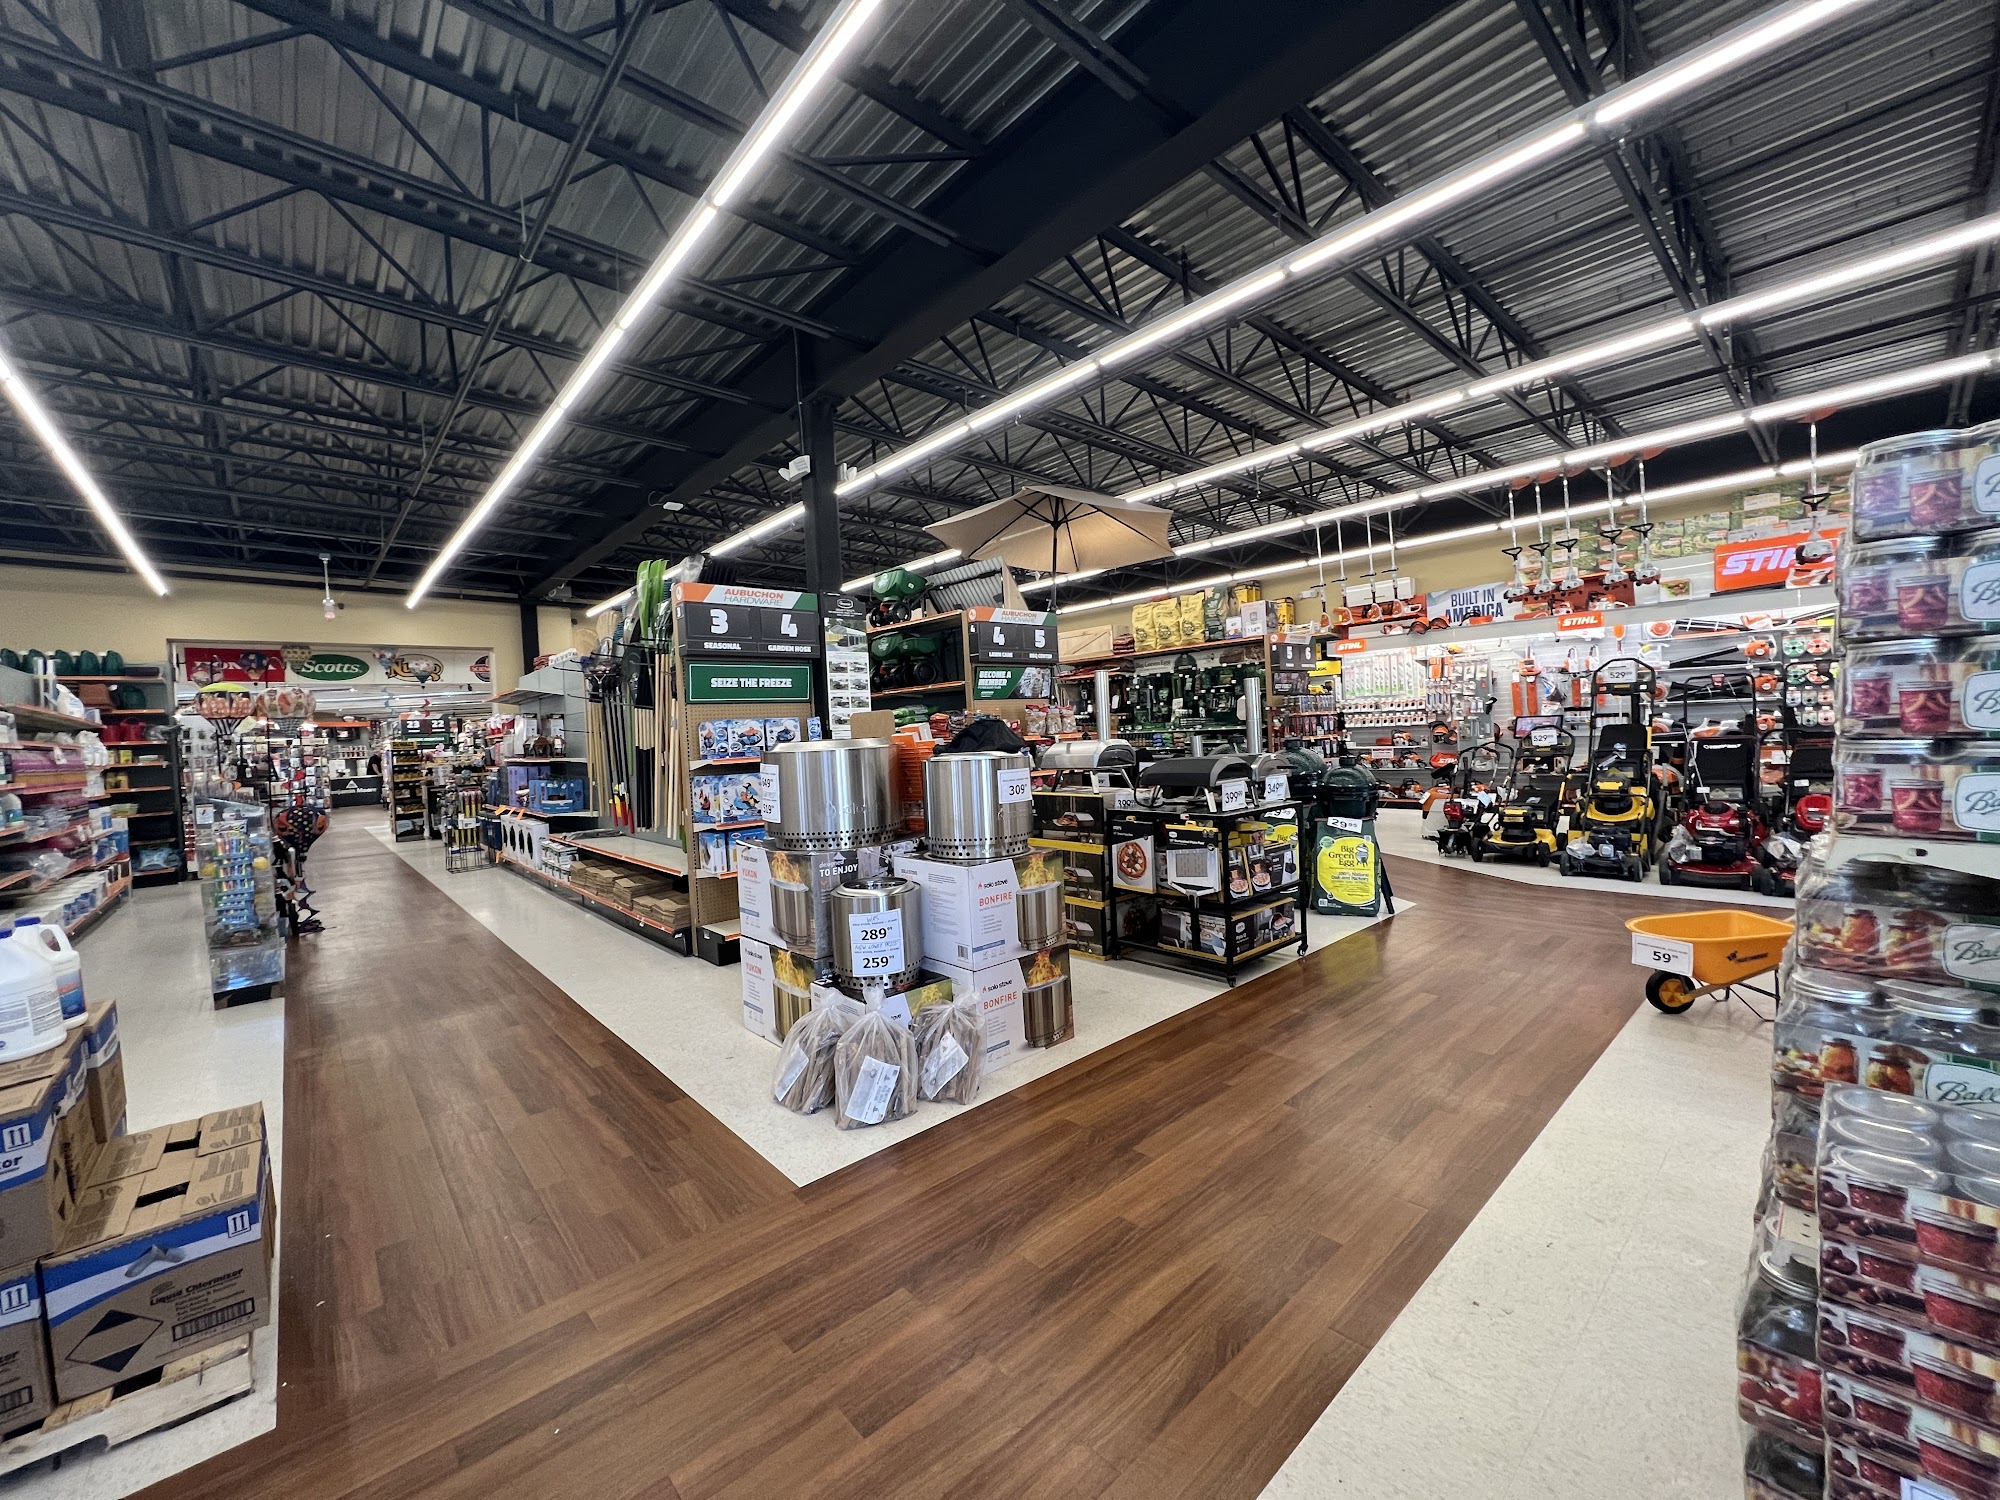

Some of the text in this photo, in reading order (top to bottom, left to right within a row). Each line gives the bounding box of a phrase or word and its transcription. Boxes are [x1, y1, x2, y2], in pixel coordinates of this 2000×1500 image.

[724, 587, 784, 600] AUBUCHON
[1450, 588, 1495, 608] BUILT IN
[723, 595, 783, 607] HARDWARE
[1001, 610, 1037, 618] AUBUCHON
[709, 608, 798, 638] 3 4
[1562, 614, 1599, 627] STIHL
[992, 626, 1006, 646] 4
[1034, 629, 1046, 648] 5
[703, 641, 742, 651] SEASONAL
[767, 644, 812, 653] GARDEN HOSE
[1337, 641, 1363, 651] STIHL
[1286, 645, 1293, 660] 5
[1305, 646, 1311, 660] 6
[301, 659, 360, 673] Scotts
[710, 677, 793, 688] SEIZE THE FREEZE
[406, 720, 445, 728] 23 22
[1331, 818, 1347, 829] 29
[1340, 845, 1355, 853] Big
[1328, 851, 1355, 860] Green
[1338, 859, 1355, 867] Egg
[819, 863, 859, 878] TO ENJOY
[979, 891, 1013, 907] BONFIRE
[983, 990, 1018, 1010] BONFIRE
